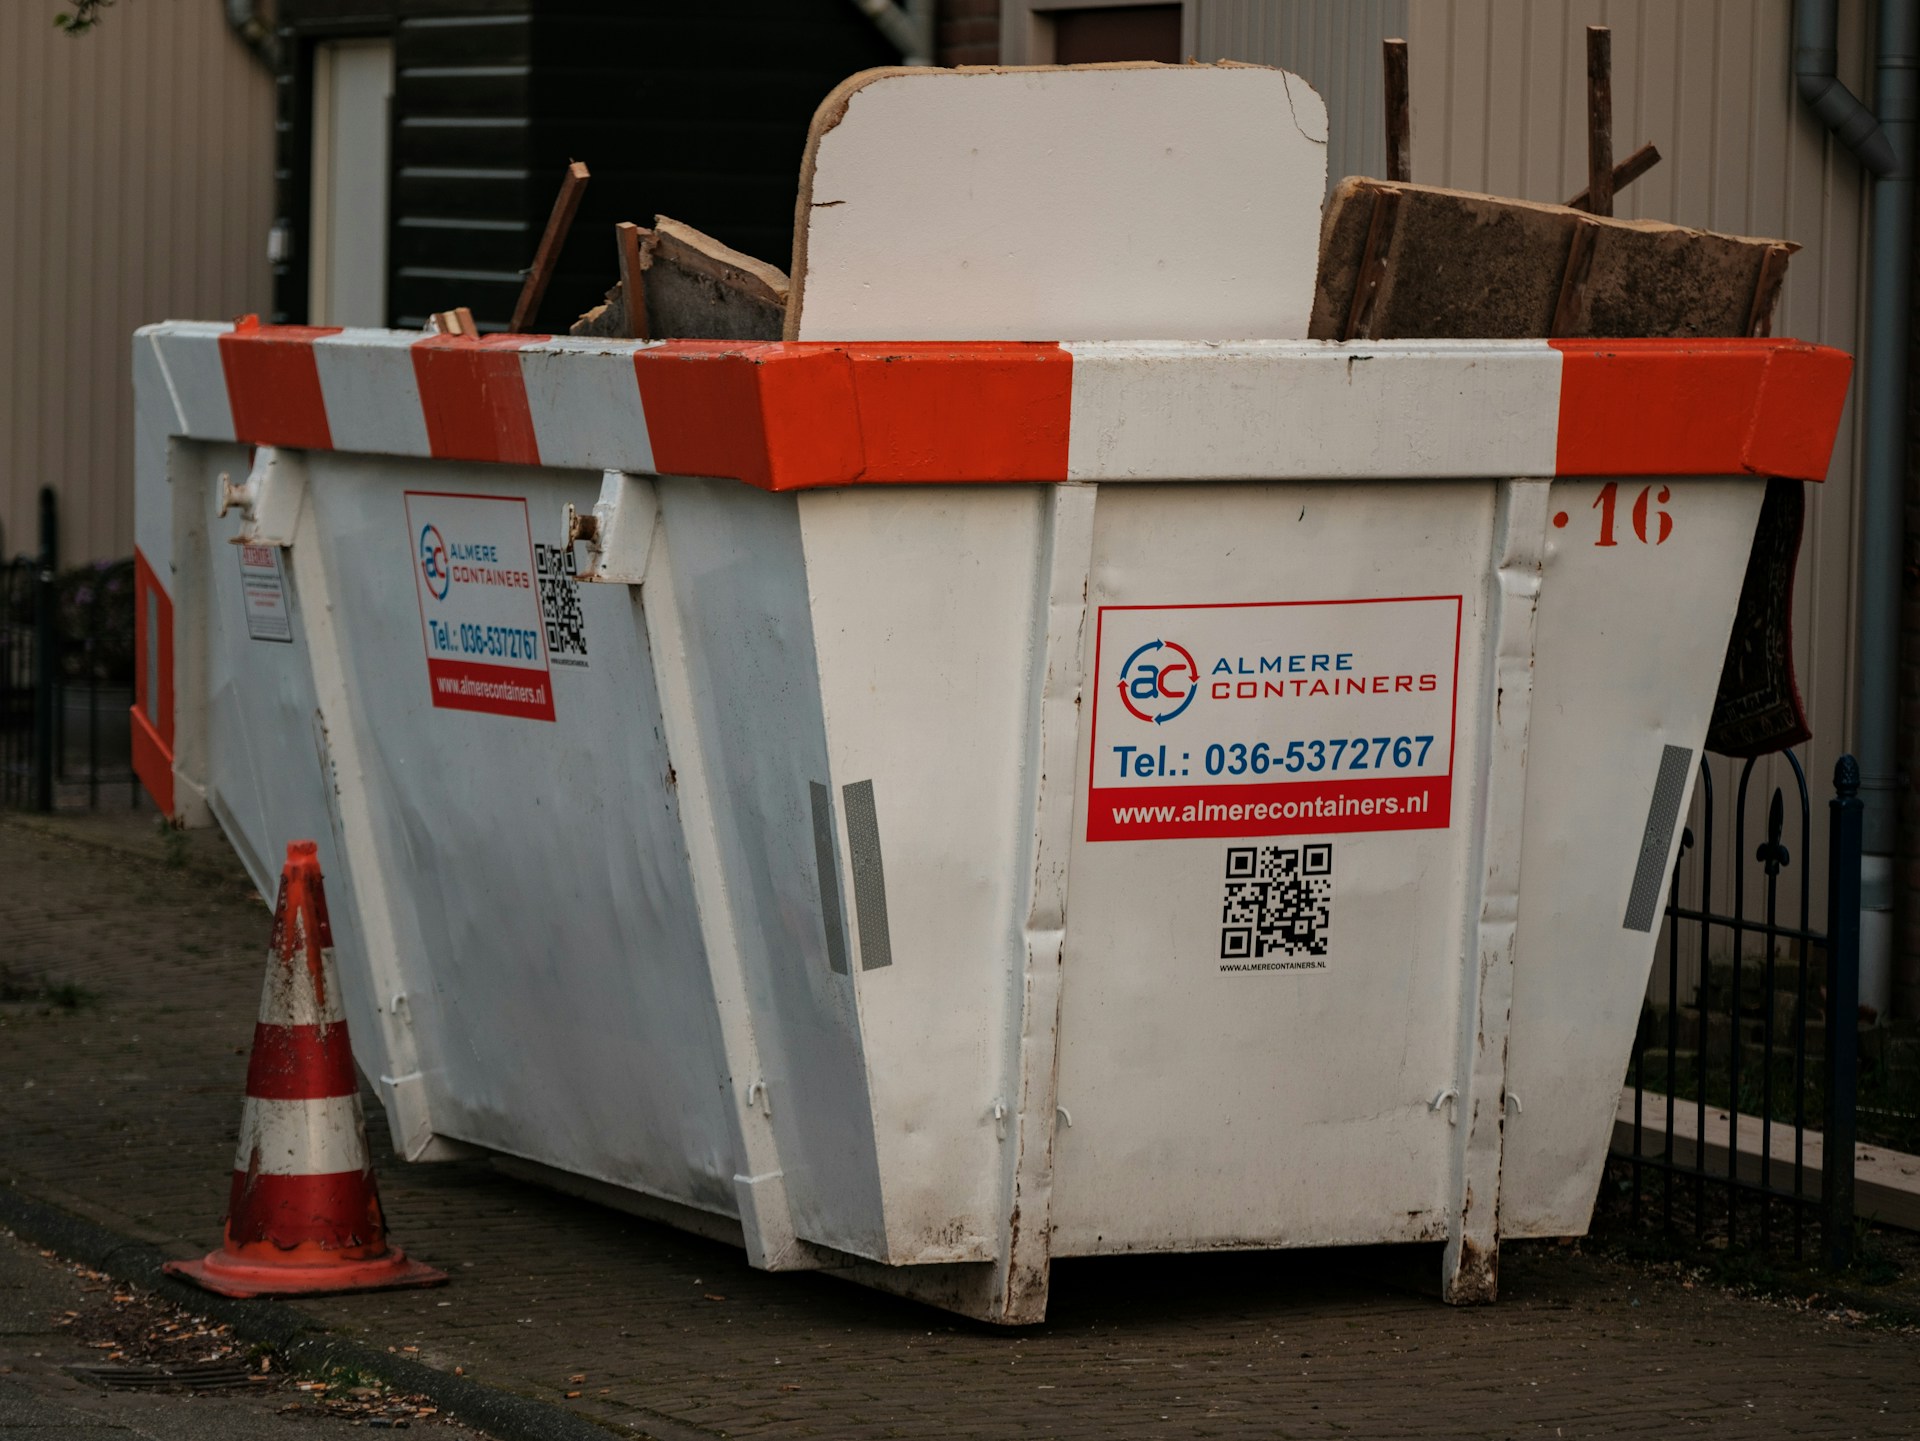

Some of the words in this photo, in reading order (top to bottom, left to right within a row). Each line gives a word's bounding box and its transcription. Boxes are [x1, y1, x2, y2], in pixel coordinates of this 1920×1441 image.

[451, 543, 498, 562] ALMERE
[453, 566, 530, 588] CONTAINERS
[429, 620, 459, 651] Tel.:
[460, 623, 537, 660] 036-5372767
[1212, 653, 1353, 675] ALMERE
[437, 676, 546, 704] www.almerecontainers.nl
[1130, 664, 1187, 699] ac
[1212, 674, 1437, 699] CONTAINERS
[1113, 745, 1190, 778] Tel.:
[1205, 735, 1434, 776] 036-5372767
[1112, 791, 1429, 824] www.almerecontainers.nl
[1220, 961, 1327, 972] WWW.ALMERECONTAINERS.NL
